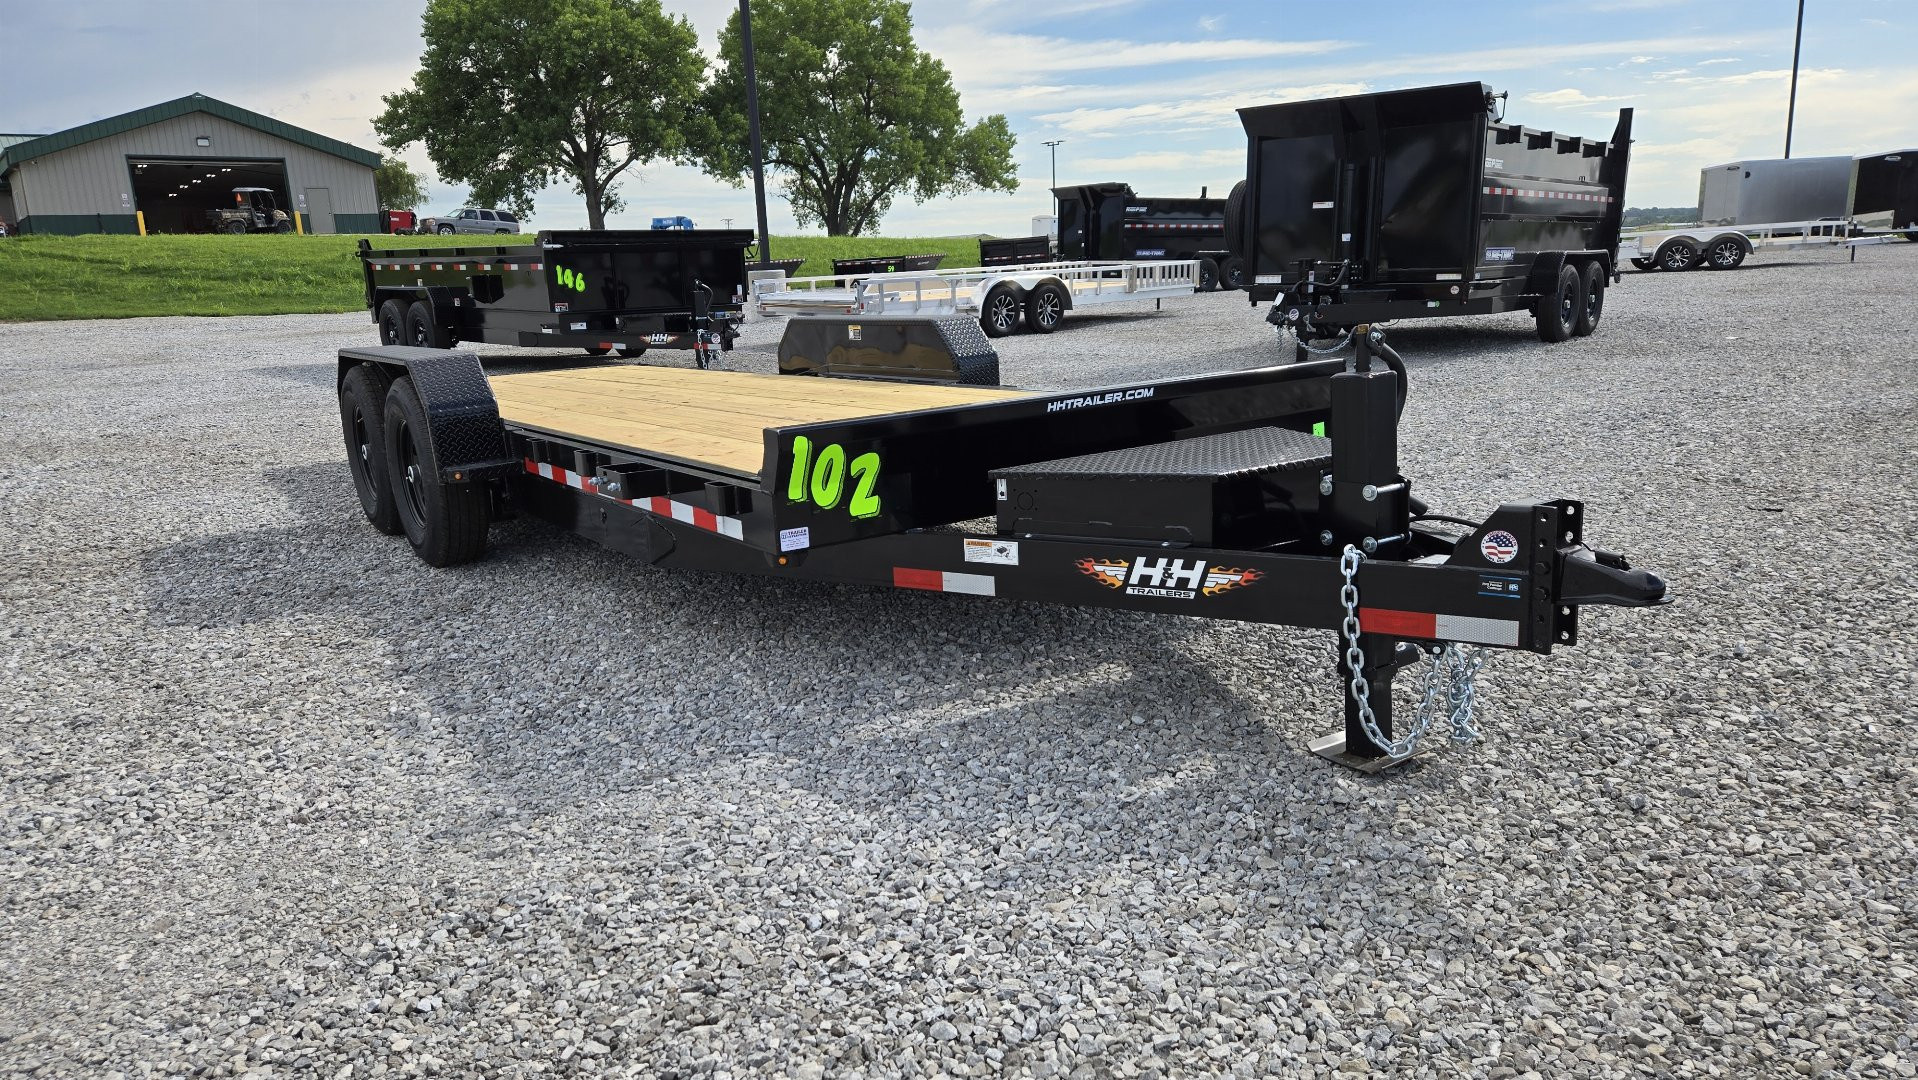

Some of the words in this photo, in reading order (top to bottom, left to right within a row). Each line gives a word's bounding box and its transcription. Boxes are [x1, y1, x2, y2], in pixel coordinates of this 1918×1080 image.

[556, 264, 586, 293] 146
[1047, 387, 1154, 412] HHTRAILER.COM
[788, 435, 881, 518] 102
[1128, 556, 1206, 589] H&H
[1130, 587, 1193, 598] TRAILERS
